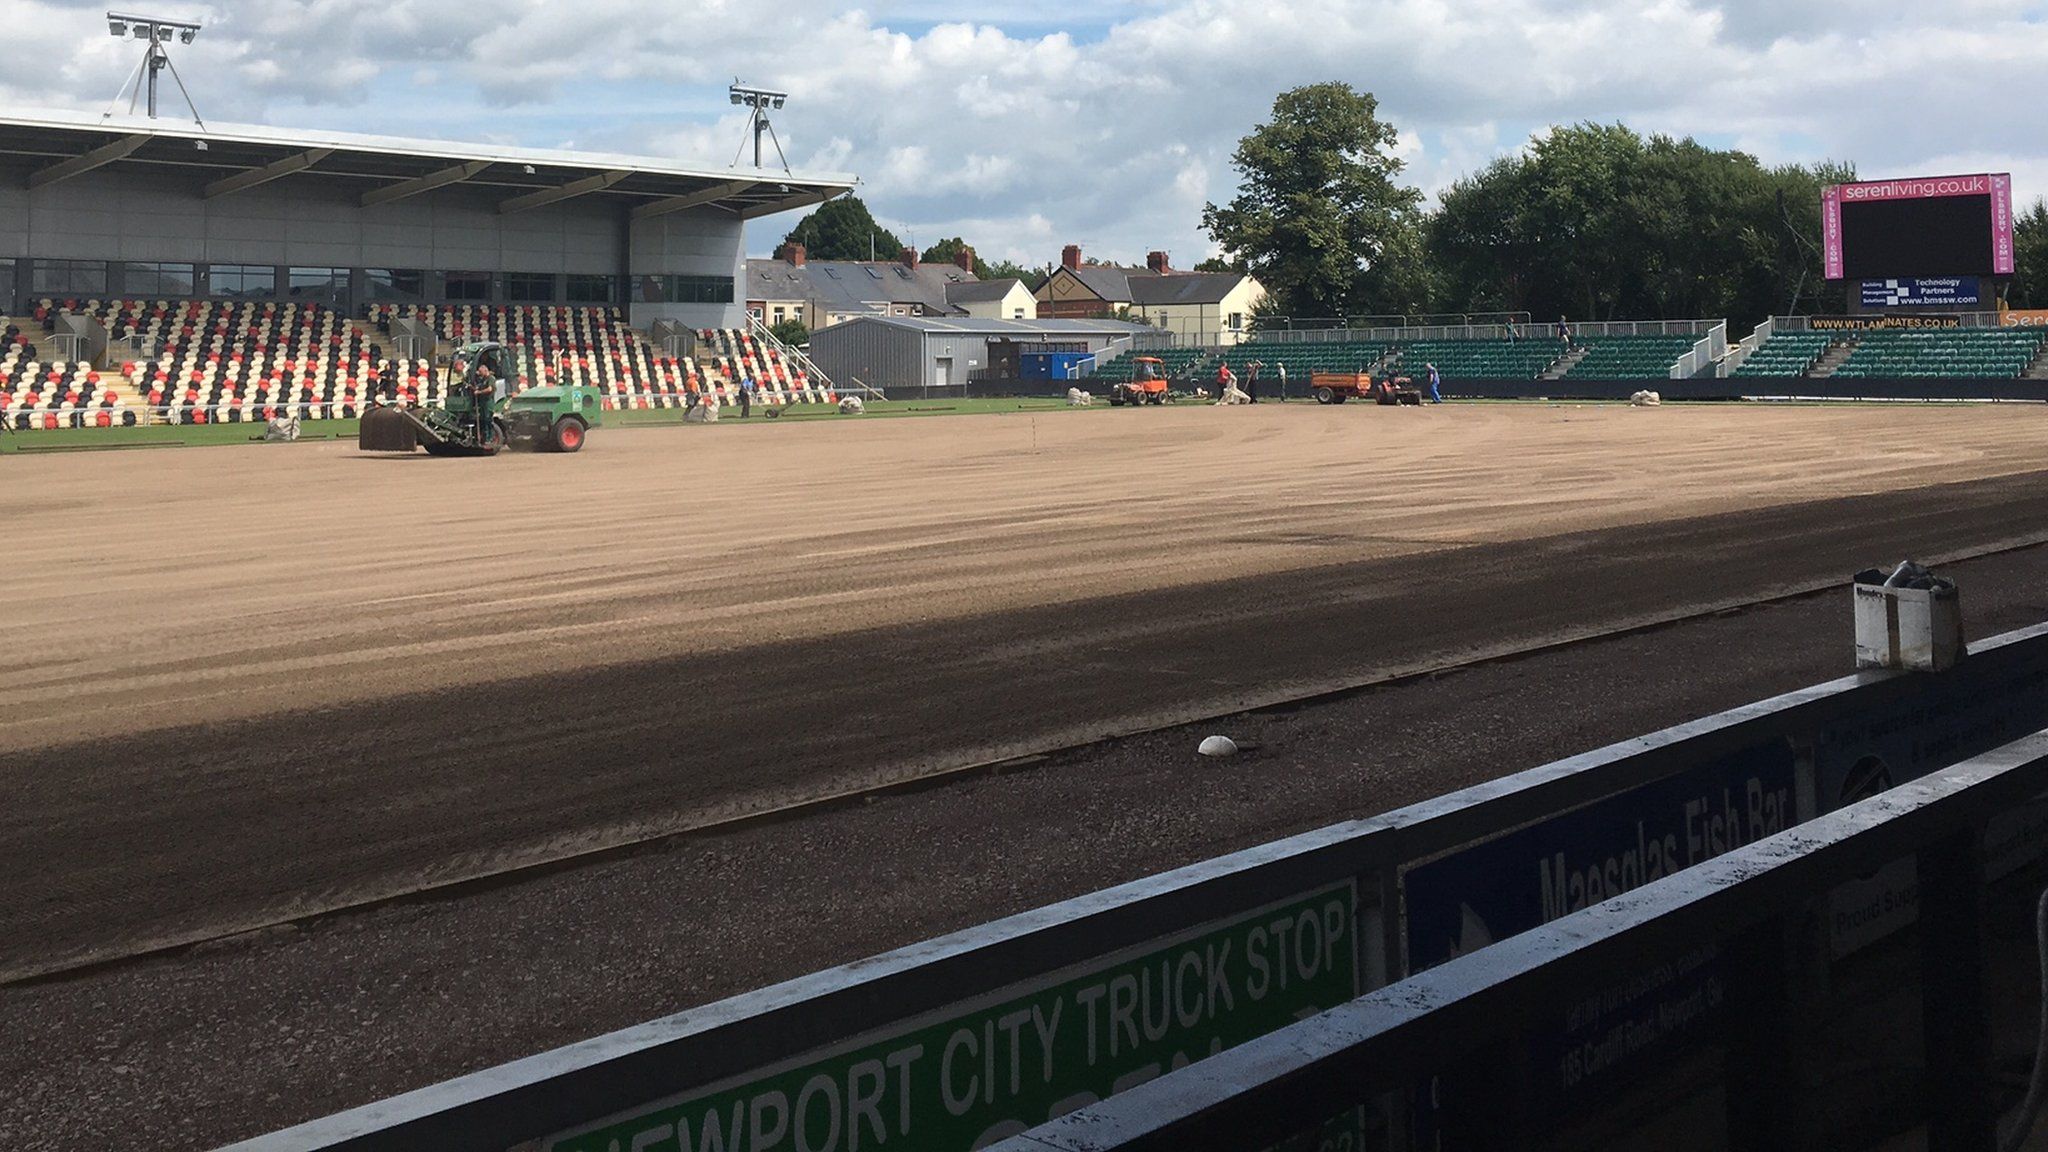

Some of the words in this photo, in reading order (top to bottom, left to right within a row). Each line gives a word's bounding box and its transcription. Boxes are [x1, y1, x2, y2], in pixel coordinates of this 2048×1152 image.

[1846, 177, 1984, 199] serenliving.co.uk
[1915, 278, 1961, 288] Technology
[1920, 287, 1955, 295] Partners
[1900, 296, 1978, 304] www.bmssw.com
[1813, 318, 1960, 329] WWW.WTLAMINATES.CO.UK
[1685, 787, 1740, 866] Fish
[1747, 777, 1787, 842] Bar
[1836, 894, 1880, 932] Proud
[575, 1043, 924, 1152] PORT
[940, 995, 1063, 1117] CITY
[1076, 938, 1234, 1065] TRUCK
[1246, 898, 1345, 1001] STOP
